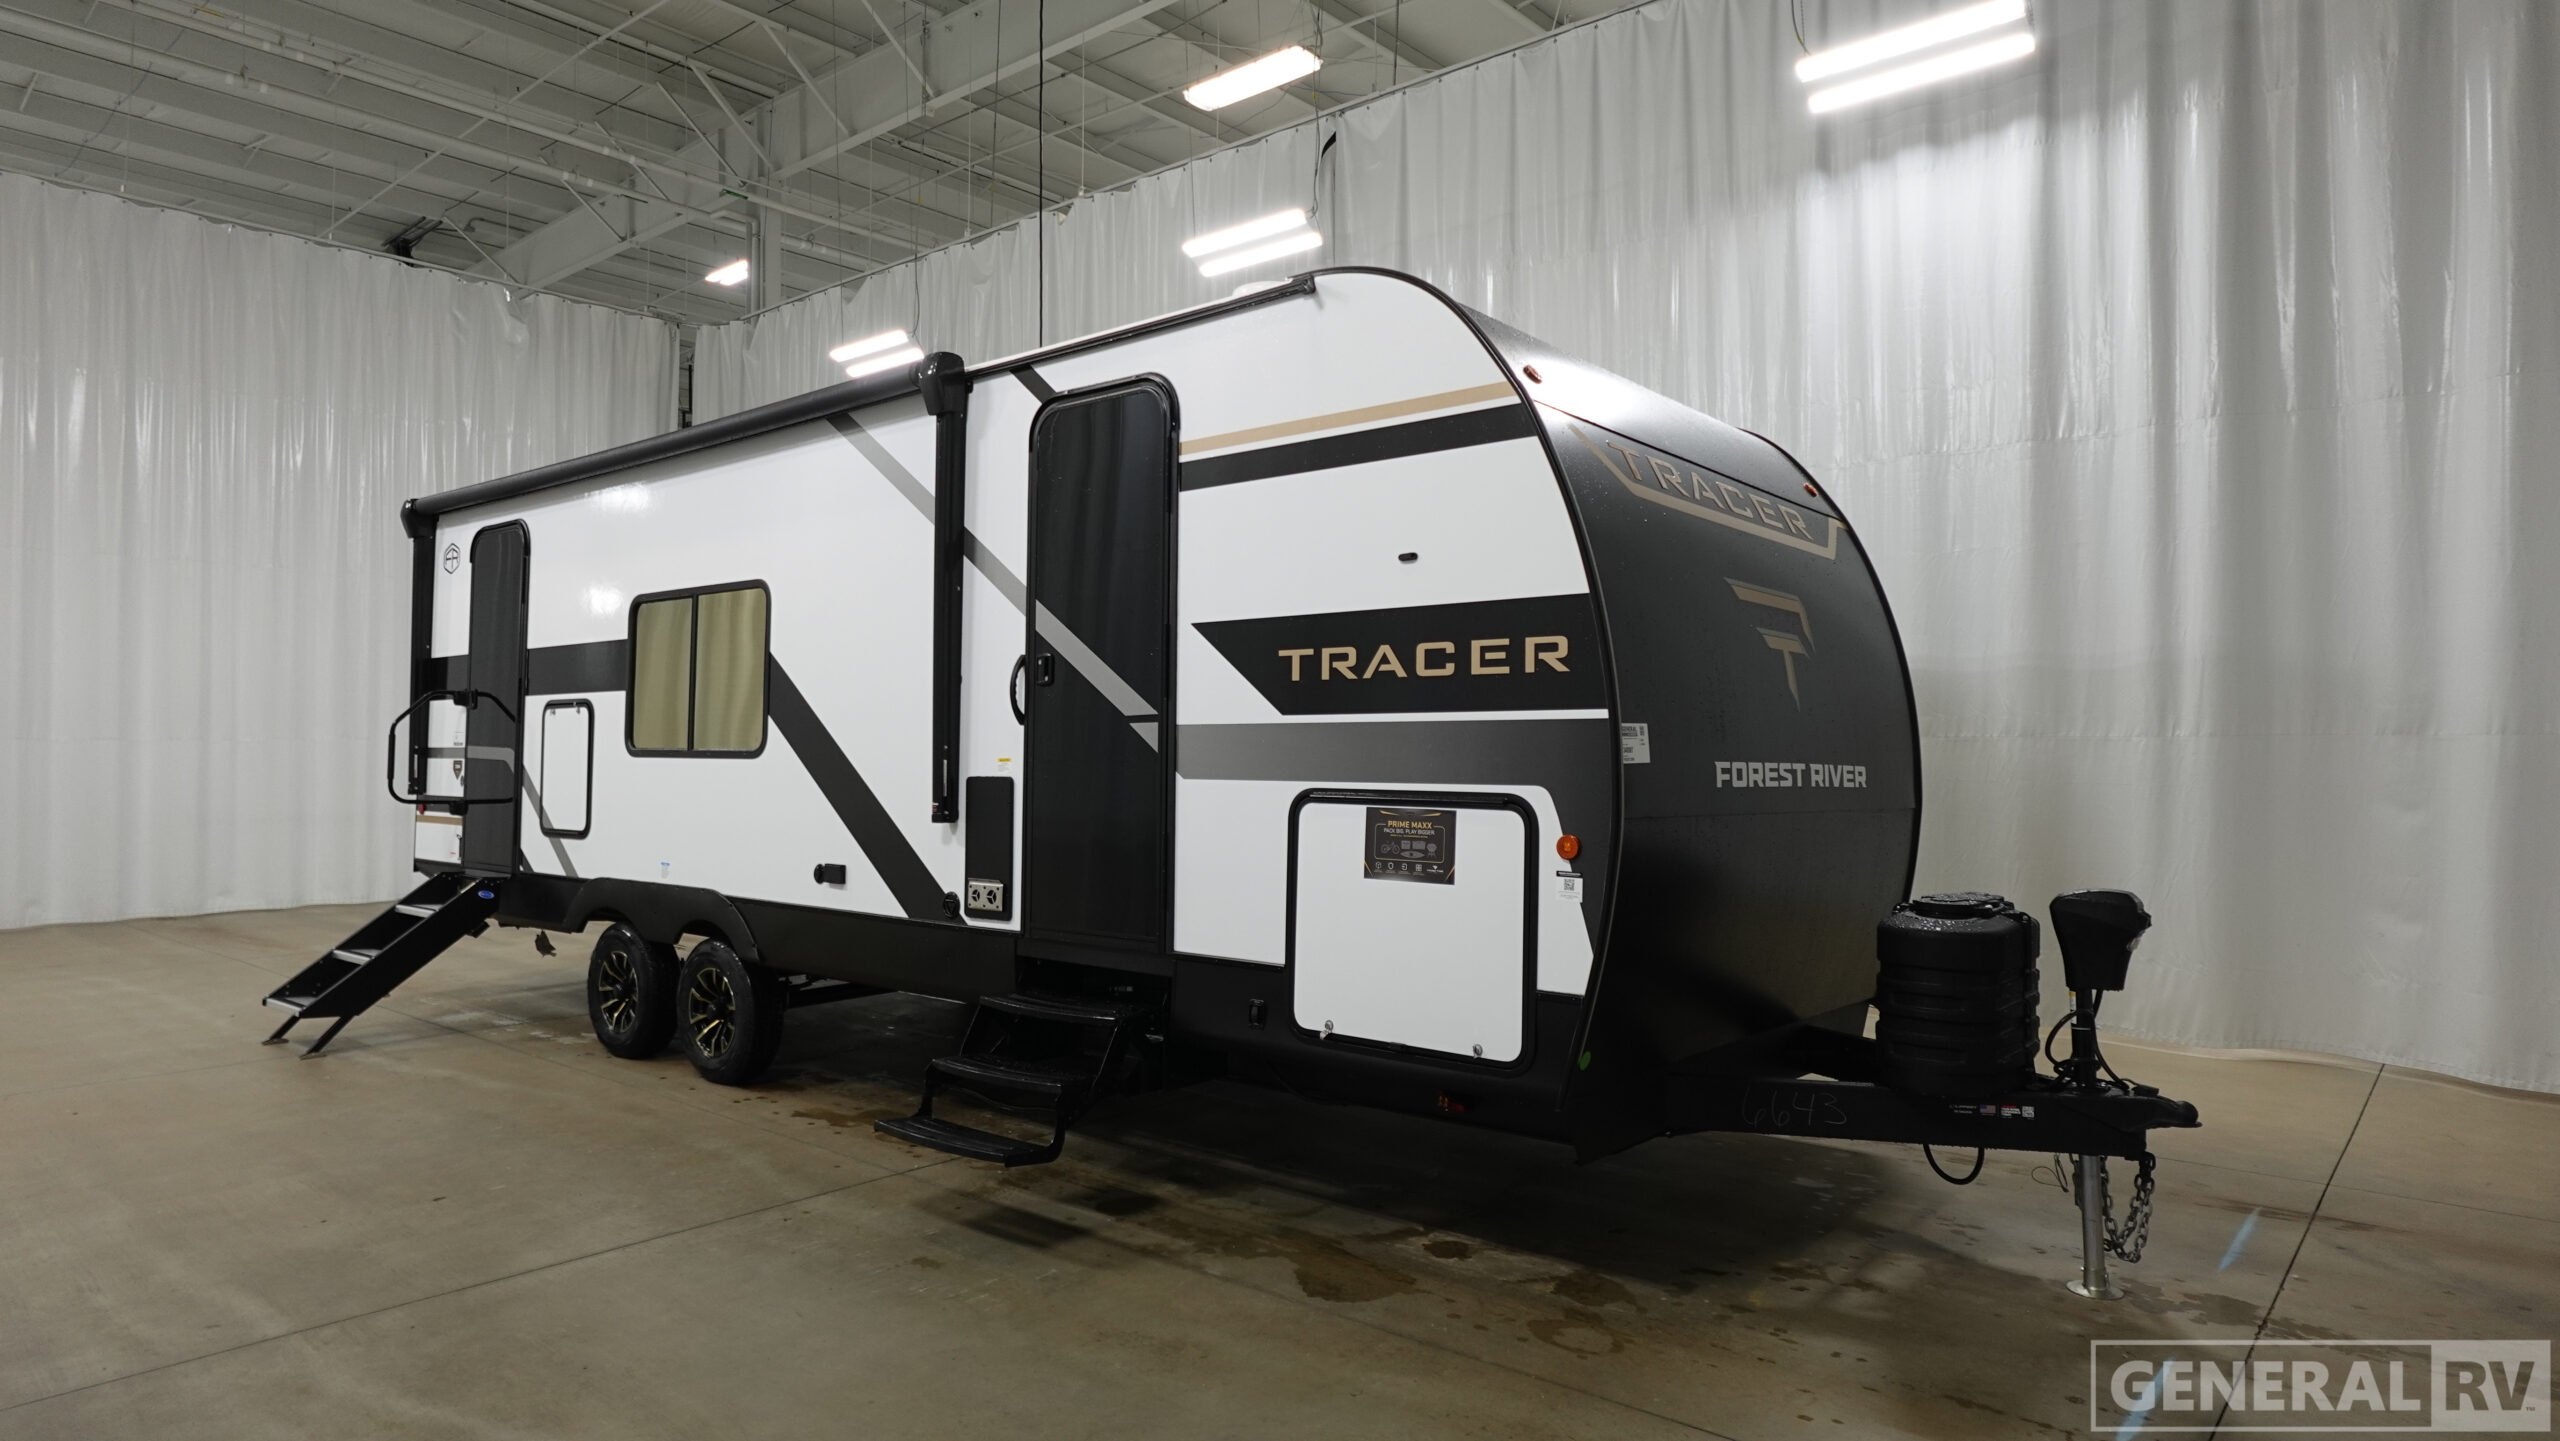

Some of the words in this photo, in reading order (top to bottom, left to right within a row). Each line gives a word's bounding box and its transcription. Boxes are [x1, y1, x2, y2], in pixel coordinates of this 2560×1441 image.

[1605, 440, 1813, 540] TRACER
[1278, 635, 1571, 682] TRACER
[1715, 761, 1805, 788] FOREST
[1810, 763, 1867, 788] RIVER
[1387, 820, 1410, 829] PRIME
[1411, 821, 1433, 829] MAXX
